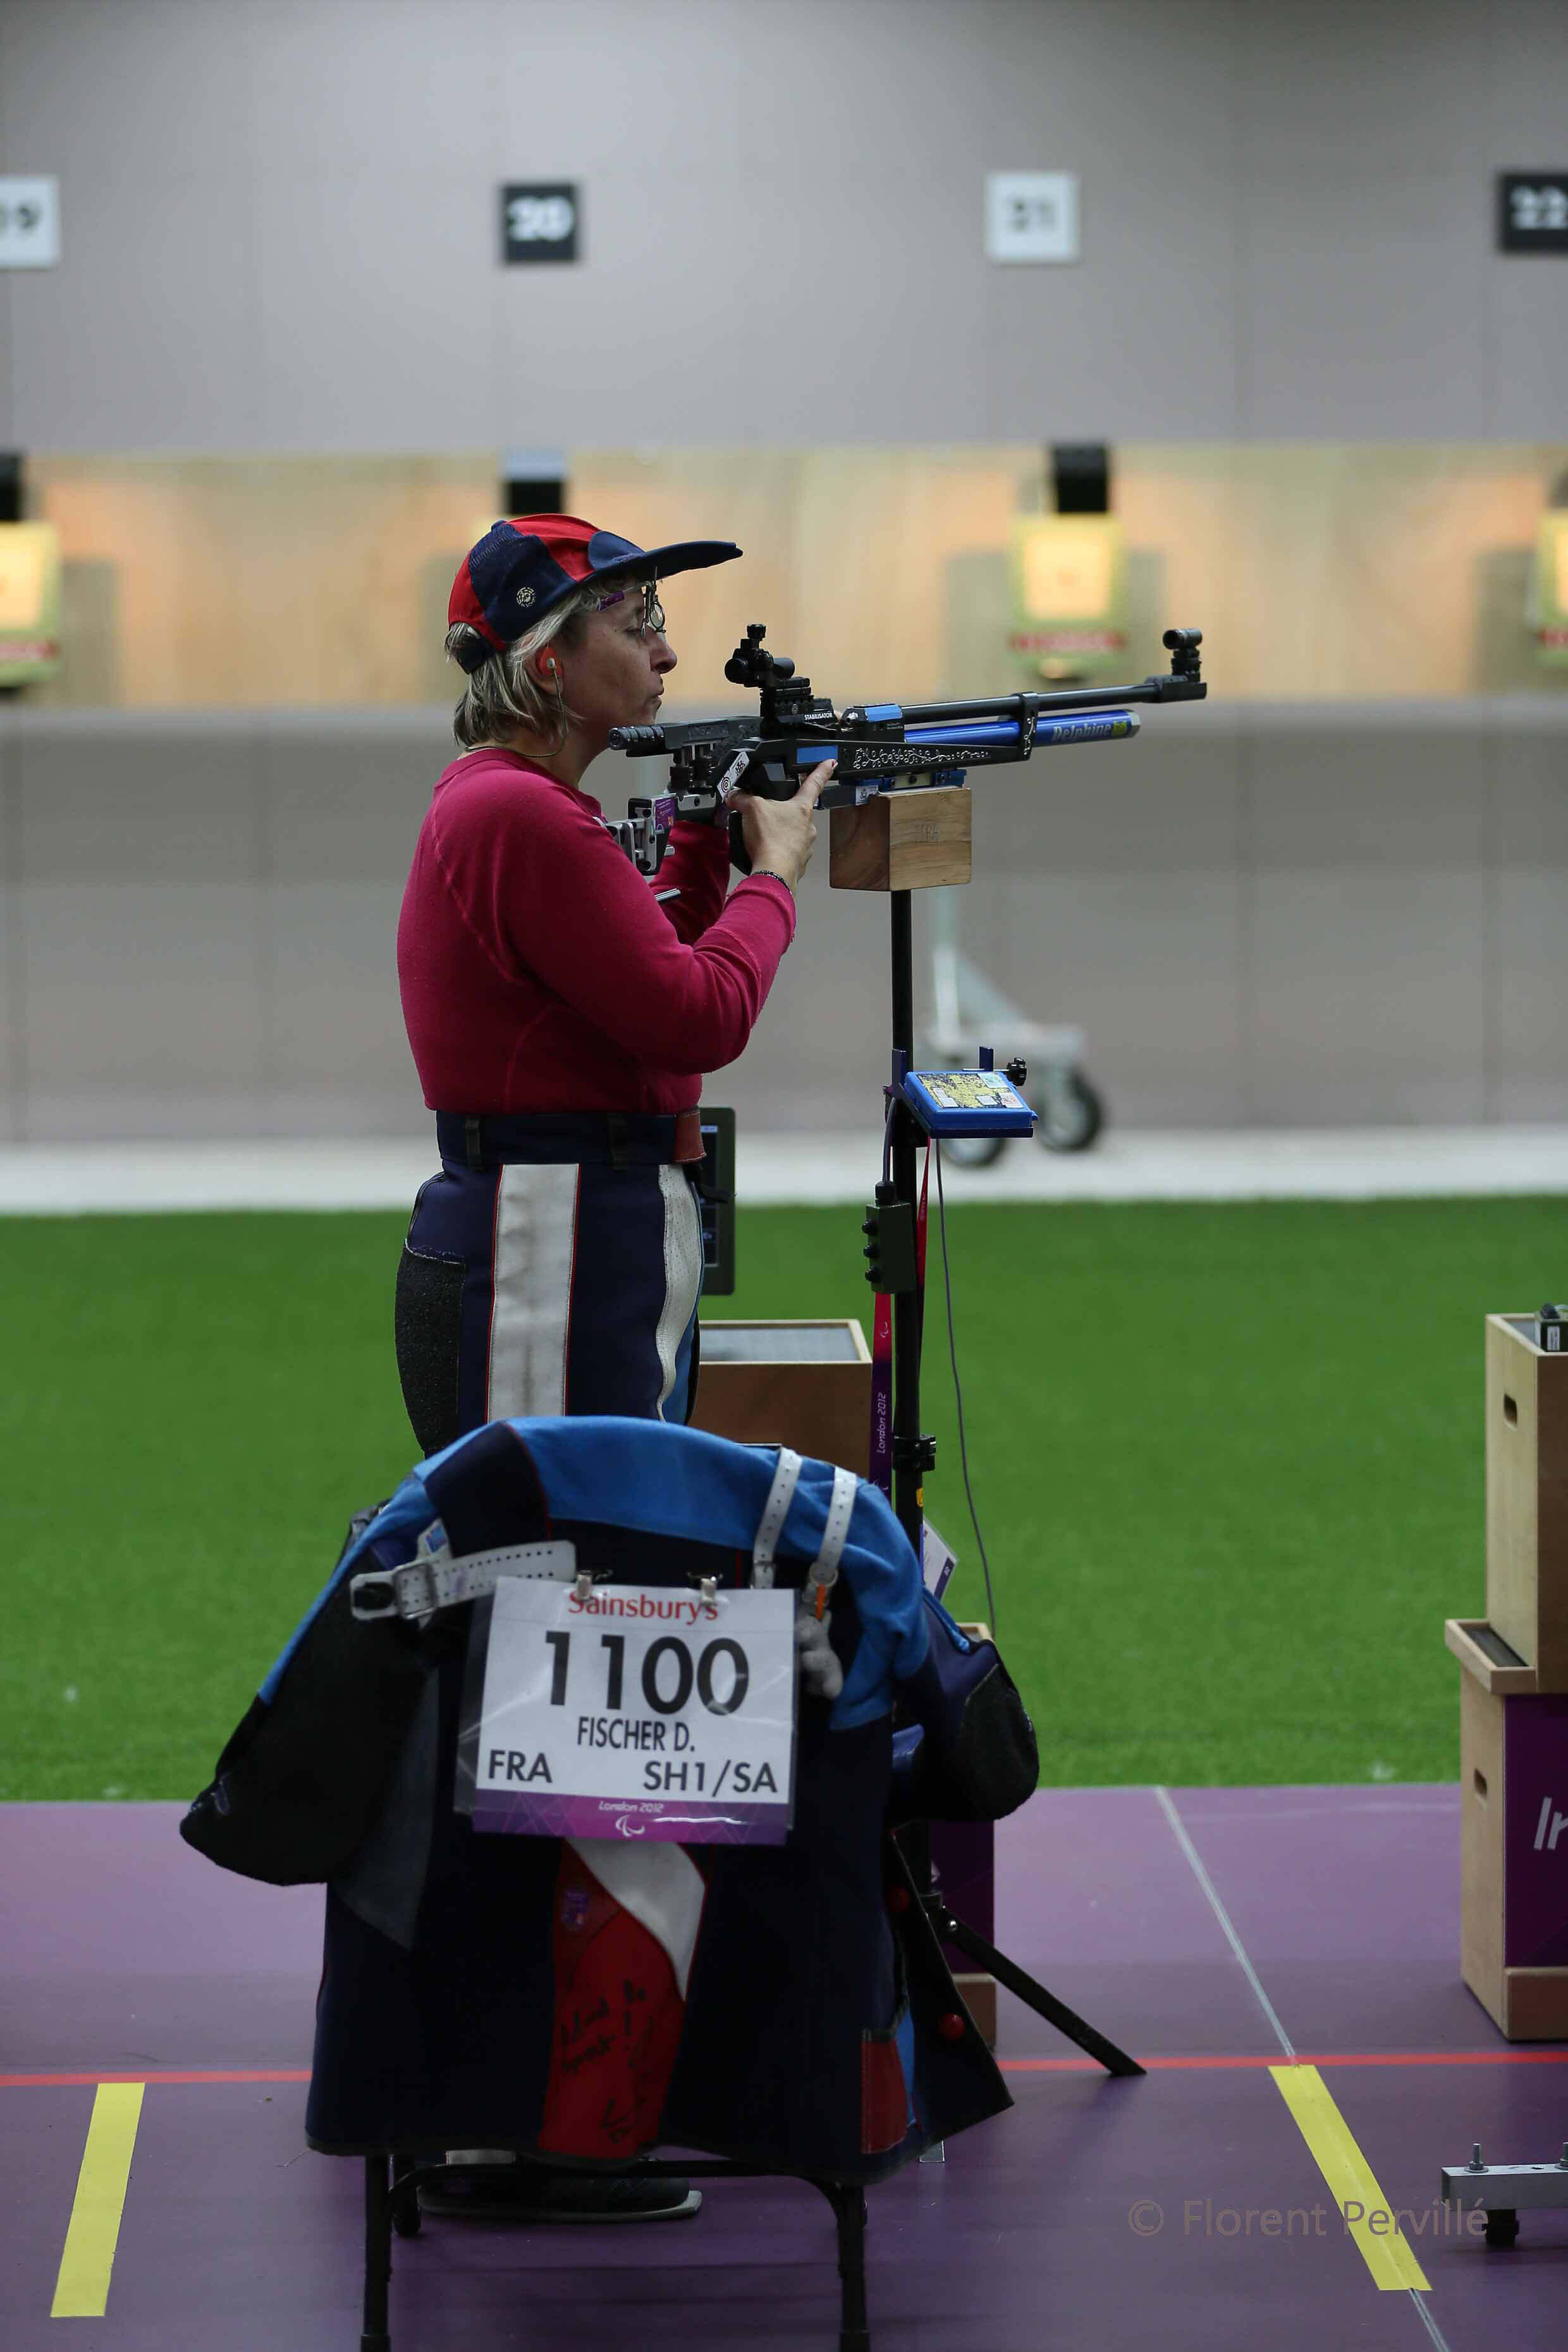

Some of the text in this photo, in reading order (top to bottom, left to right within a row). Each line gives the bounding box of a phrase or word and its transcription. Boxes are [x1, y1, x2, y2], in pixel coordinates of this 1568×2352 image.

[1052, 723, 1112, 739] Delphine
[876, 1392, 886, 1454] London 2012
[568, 1590, 719, 1625] Sainsburys
[545, 1630, 749, 1716] 1100
[577, 1716, 695, 1752] FISCHER D.
[488, 1749, 553, 1783] FRA
[643, 1760, 778, 1798] SH1/SA
[598, 1800, 665, 1813] London 2012
